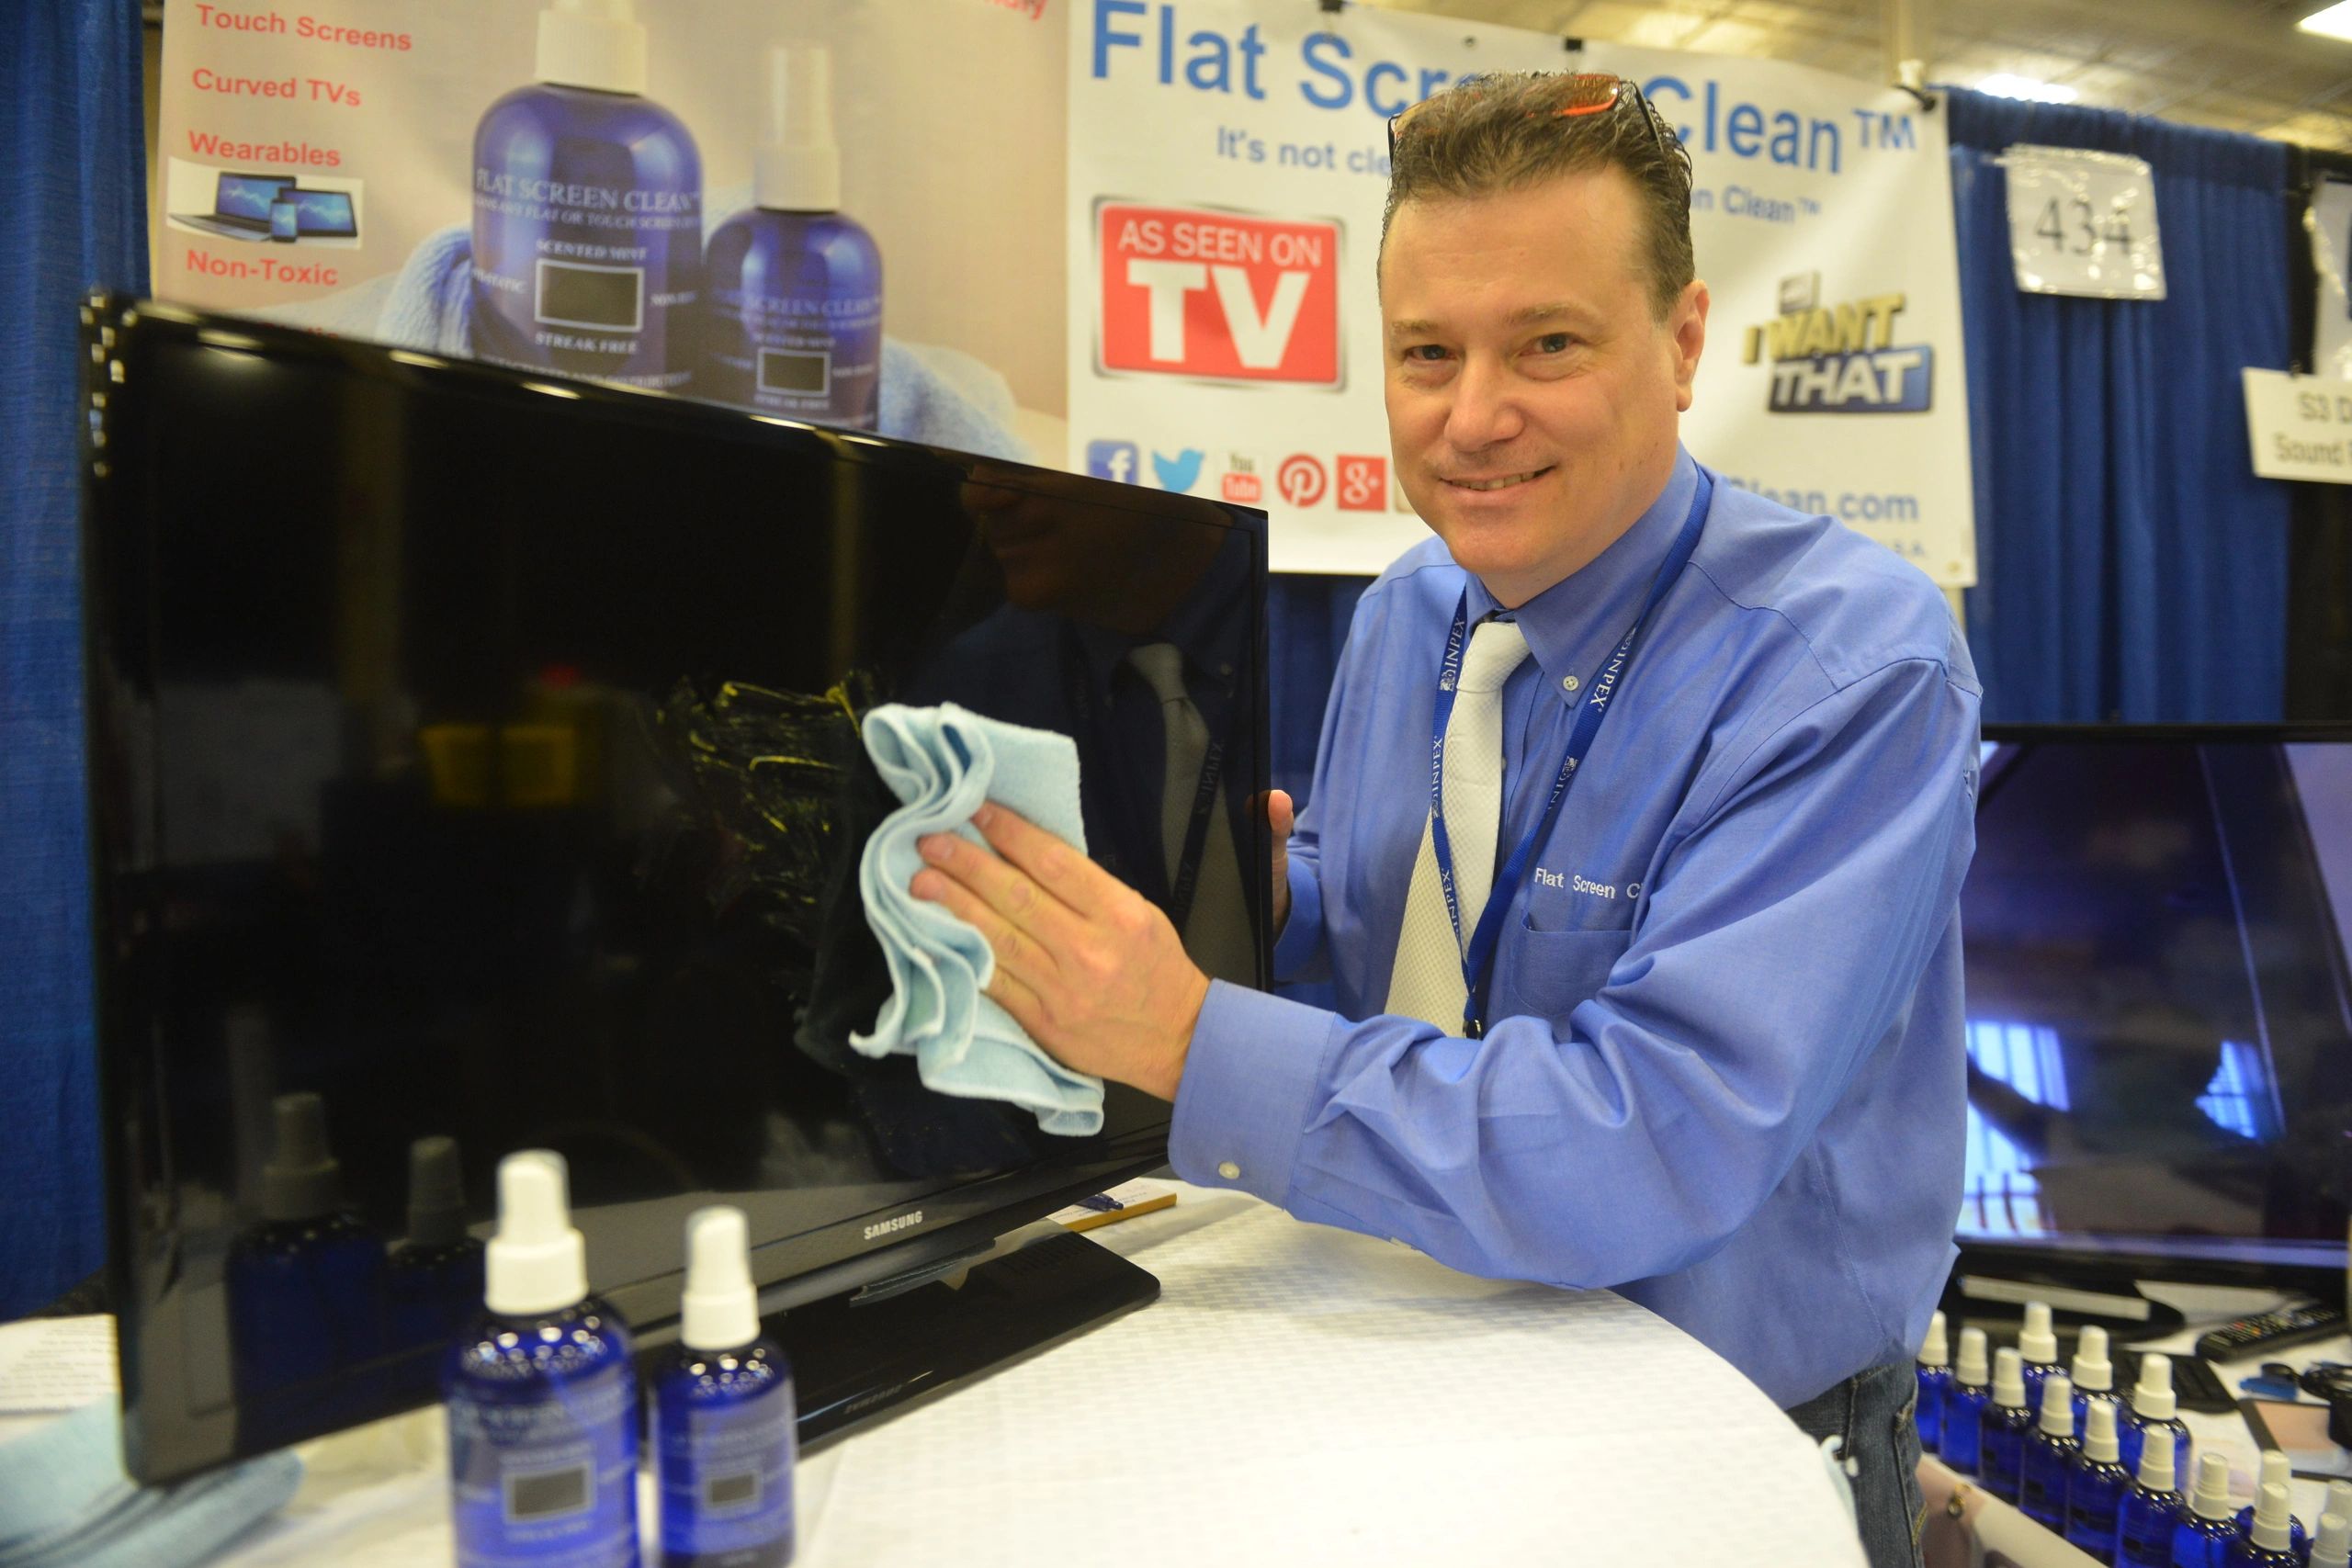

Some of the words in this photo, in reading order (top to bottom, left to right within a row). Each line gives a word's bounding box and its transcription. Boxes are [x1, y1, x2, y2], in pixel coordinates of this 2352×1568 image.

[196, 4, 287, 34] Touch
[296, 16, 413, 51] Screens
[1091, 0, 1267, 100] Flat
[191, 67, 297, 99] Curved
[306, 79, 362, 107] TVs
[187, 130, 342, 167] Wearables
[1217, 126, 1266, 164] It's
[1279, 143, 1336, 171] not
[518, 177, 618, 210] SCREEN
[1117, 219, 1166, 254] AS
[1171, 222, 1263, 265] SEEN
[1270, 232, 1322, 268] ON
[186, 249, 339, 286] Non-Toxic
[1126, 257, 1312, 369] TV
[1764, 292, 1905, 363] WANT
[600, 339, 638, 355] FREE
[1771, 351, 1923, 406] THAT
[1444, 618, 1466, 672] INPEX
[1590, 652, 1626, 708] INPEX
[1431, 736, 1443, 797] INPEX
[1534, 867, 1565, 888] Flat
[1573, 874, 1616, 899] Screen
[864, 1211, 923, 1240] SAMSUNG
